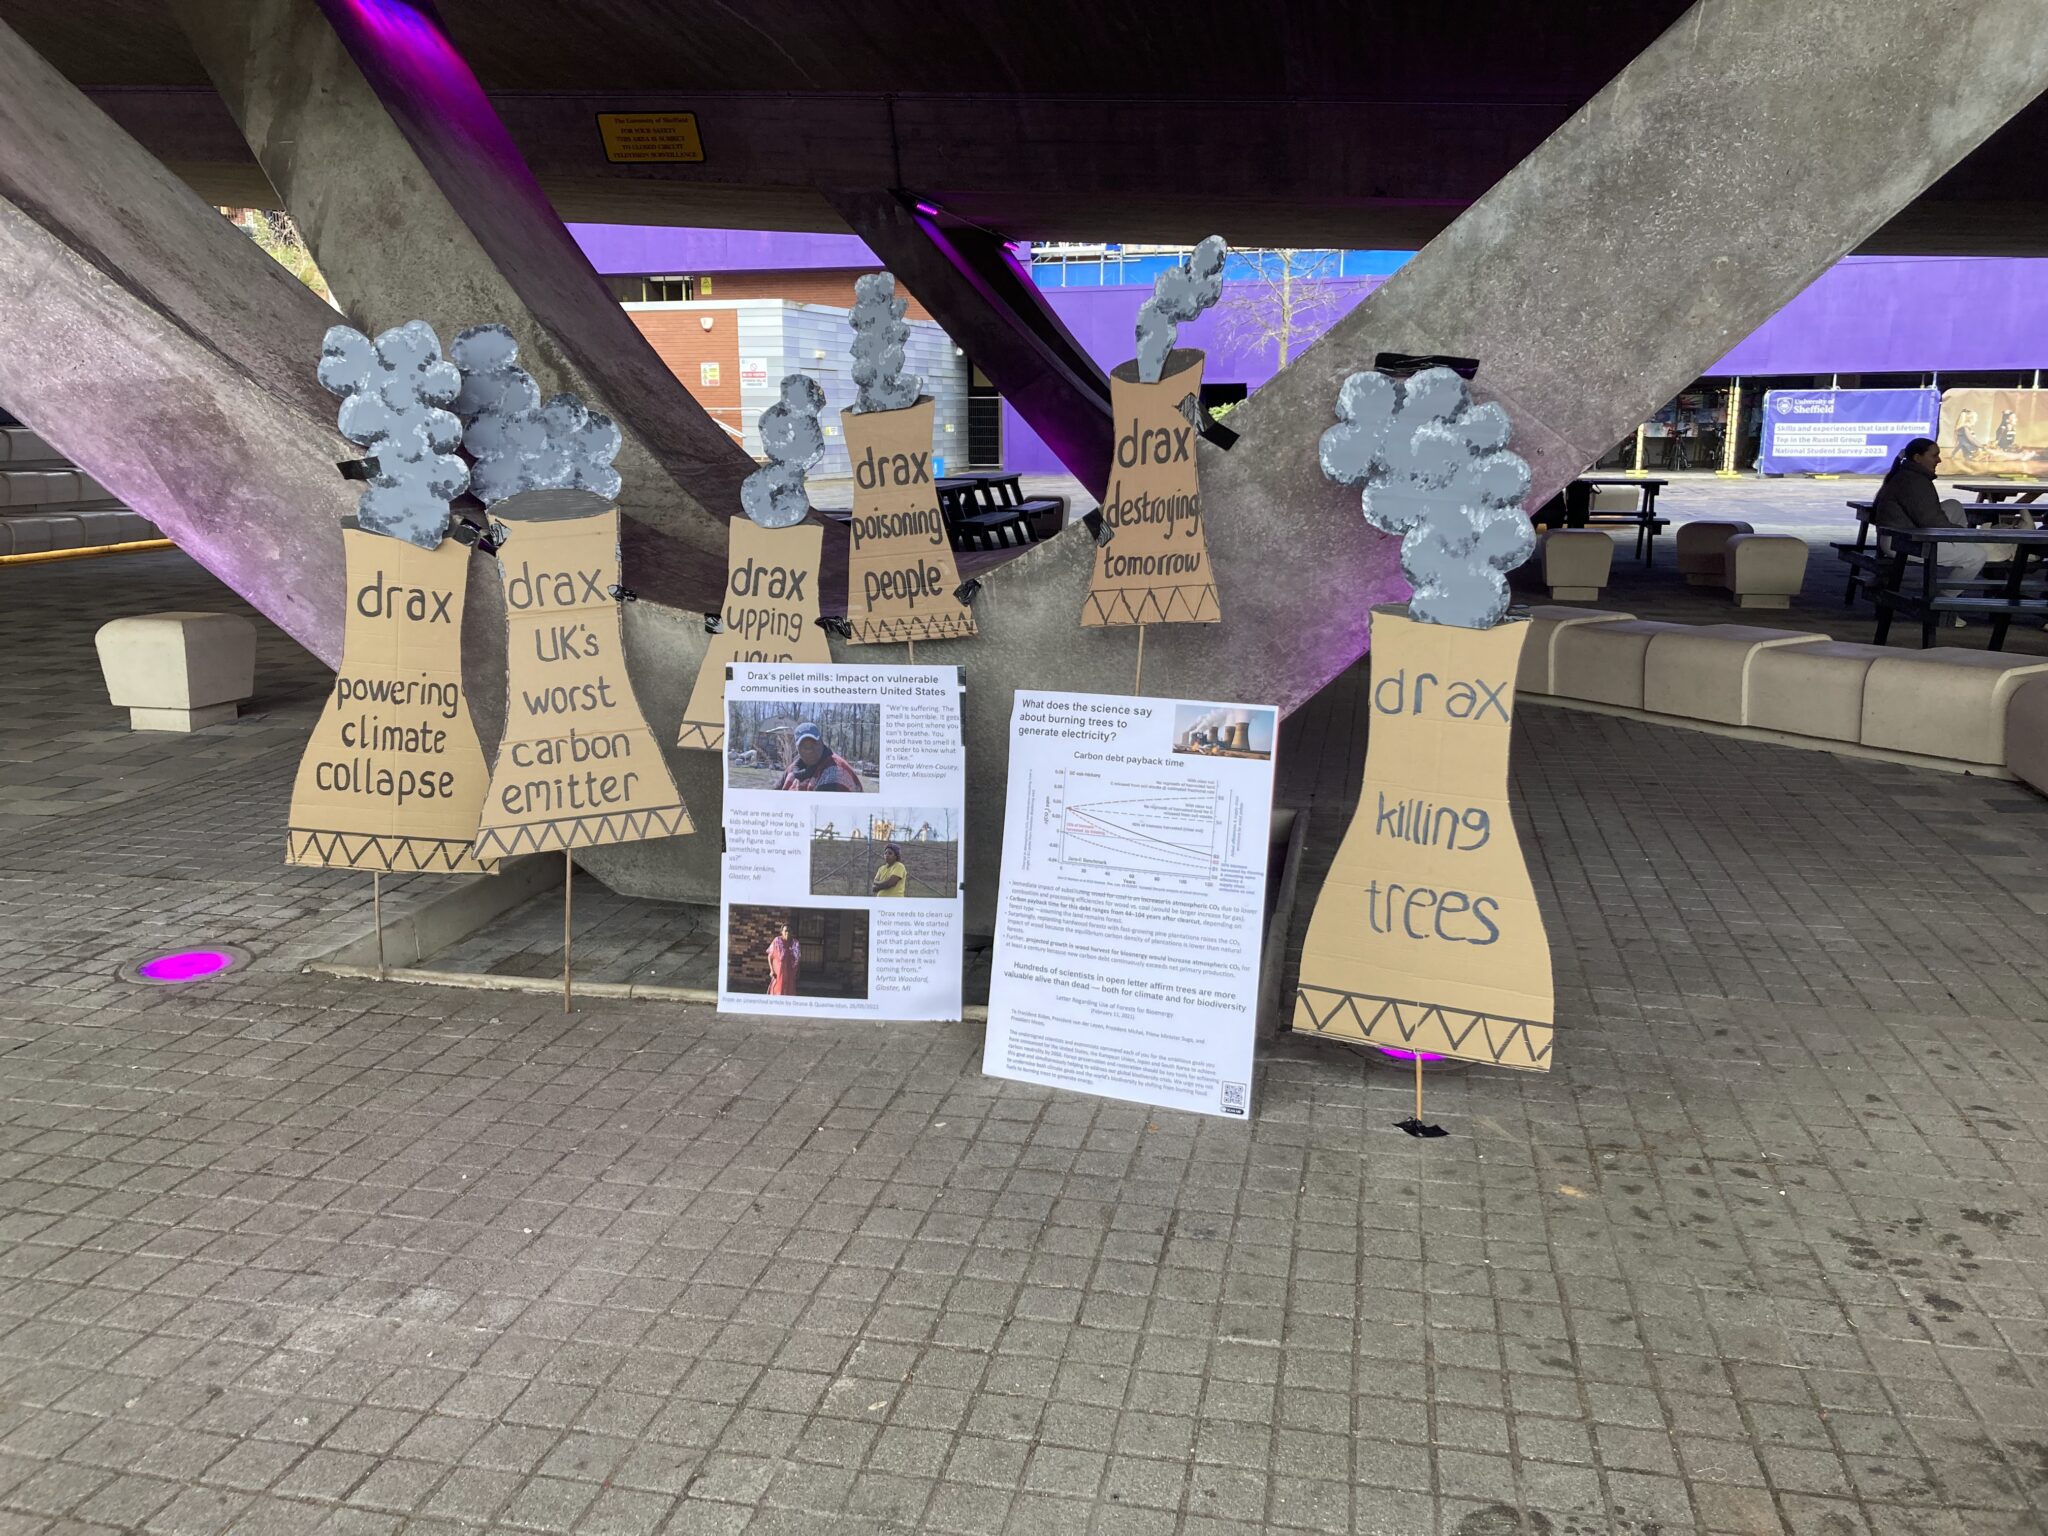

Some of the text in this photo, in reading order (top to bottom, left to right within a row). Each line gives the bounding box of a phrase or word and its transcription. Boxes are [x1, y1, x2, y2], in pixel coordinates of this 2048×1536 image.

[1794, 405, 1834, 413] Sheffield
[1118, 418, 1191, 468] drax
[1776, 436, 1788, 445] Top
[1839, 436, 1864, 445] Group.
[1812, 425, 1856, 434] experiences
[856, 446, 929, 490] drax
[1836, 447, 1862, 456] Survey
[852, 504, 943, 550] poisoning
[1106, 481, 1200, 539] destroying
[731, 558, 807, 600] drax
[1104, 546, 1200, 579] tomorrow
[357, 571, 453, 623] drax
[509, 562, 607, 610] drax
[865, 558, 942, 612] people
[535, 624, 600, 662] UK's
[727, 607, 803, 643] upping
[337, 673, 458, 718] powering
[523, 676, 616, 716] worst
[741, 684, 946, 696] communities in southeastern United States
[748, 672, 776, 680] Drax's
[778, 672, 804, 683] pellet
[806, 673, 832, 682] mills:
[835, 674, 868, 684] Impact
[887, 674, 938, 684] vulnerable
[1375, 669, 1510, 723] drax
[906, 722, 923, 730] point
[1020, 713, 1127, 728] about burning trees to
[1022, 700, 1152, 718] What does the science say
[342, 716, 447, 754] climate
[512, 728, 631, 767] carbon
[1018, 726, 1117, 744] generate electricity?
[1074, 751, 1184, 768] Carbon debt payback time
[316, 758, 454, 805] collapse
[502, 772, 638, 814] emitter
[1376, 791, 1490, 850] killing
[1365, 879, 1499, 945] trees
[876, 928, 899, 937] getting
[930, 929, 945, 937] they
[876, 938, 887, 946] put
[903, 938, 920, 946] plant
[1004, 968, 1247, 1012] valuable alive than dead both for climate and for biodiversity
[1014, 961, 1048, 973] Hundreds
[1049, 966, 1057, 974] of
[1058, 967, 1094, 979] scientists
[1096, 972, 1103, 981] in
[1105, 975, 1125, 986] open
[1127, 977, 1147, 987] letter
[1149, 980, 1173, 990] affirm
[1175, 983, 1196, 994] trees
[1214, 990, 1236, 999] more
